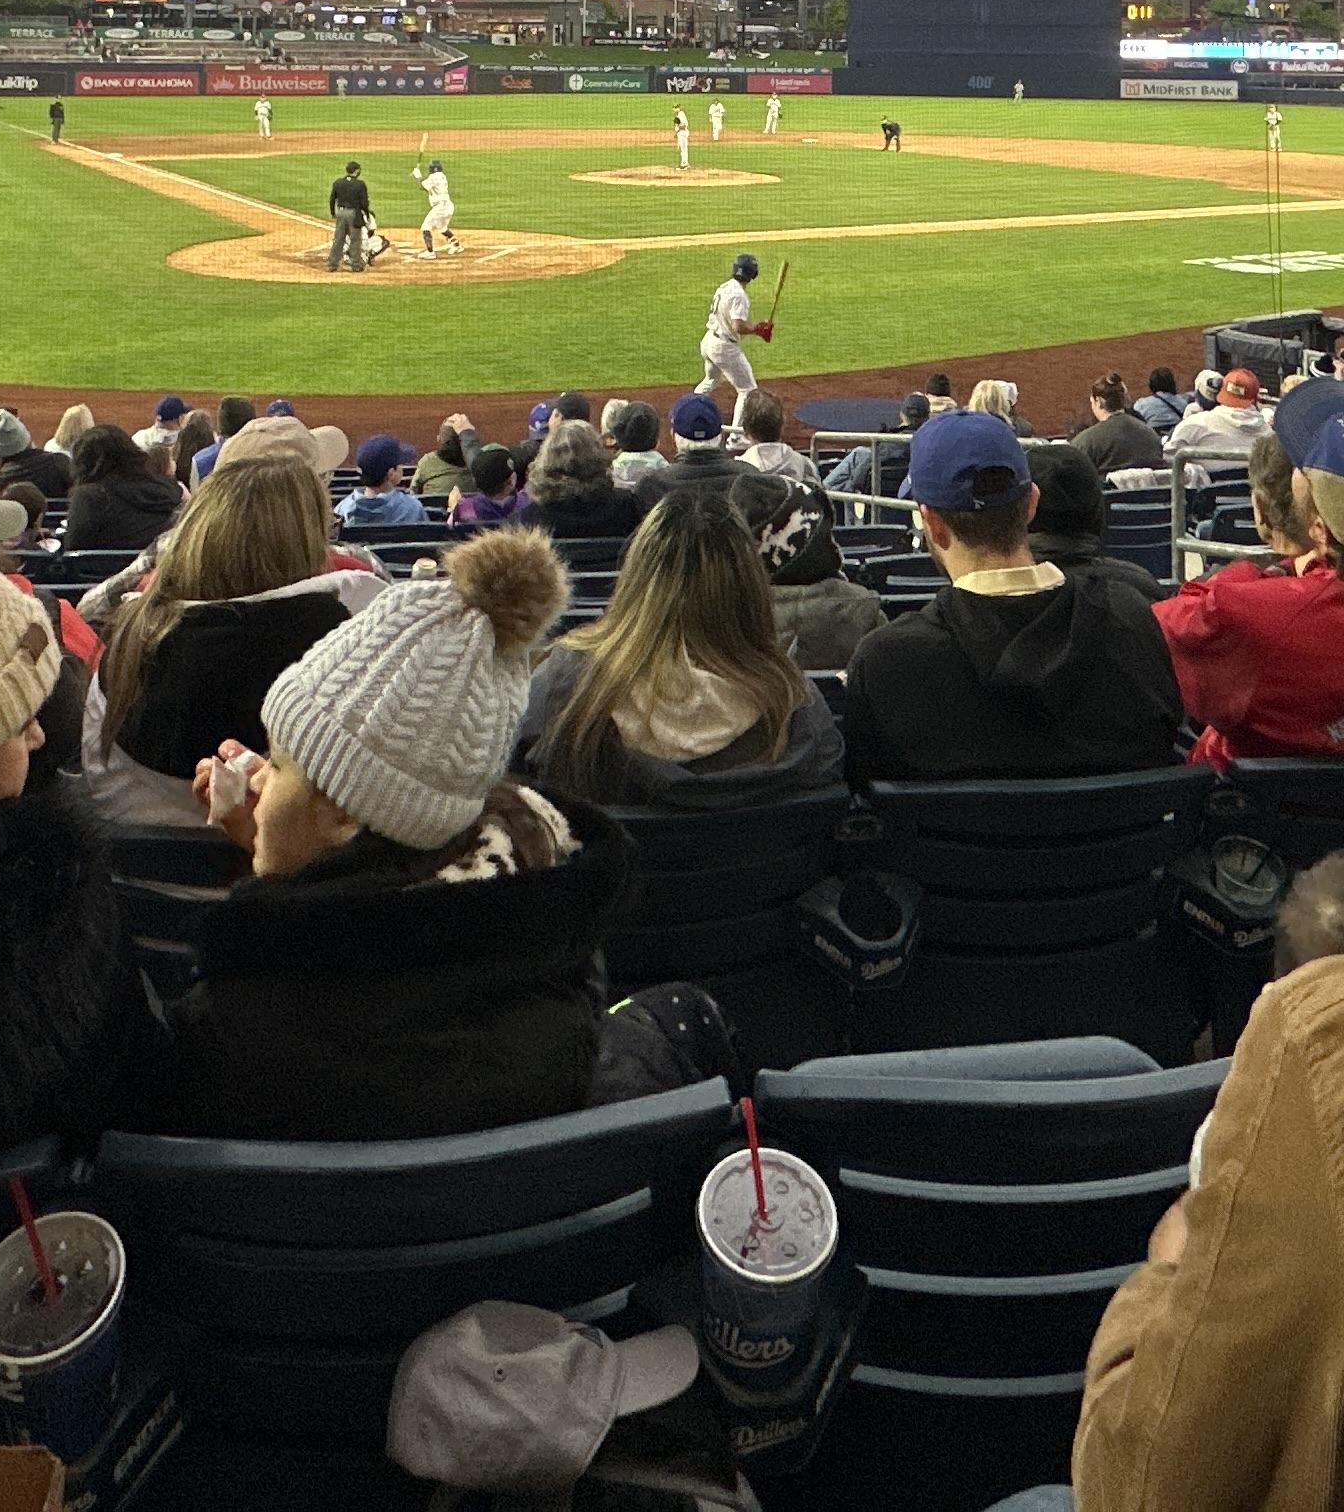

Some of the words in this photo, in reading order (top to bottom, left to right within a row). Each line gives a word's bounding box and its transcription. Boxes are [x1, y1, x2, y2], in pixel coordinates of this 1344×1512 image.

[9, 28, 56, 38] TERRACE
[148, 29, 195, 39] TERRACE
[314, 31, 356, 41] TERRACE
[94, 78, 121, 88] BANK
[123, 78, 136, 88] OF
[137, 78, 193, 88] OKLAHOMA
[583, 79, 641, 89] CommunityCare
